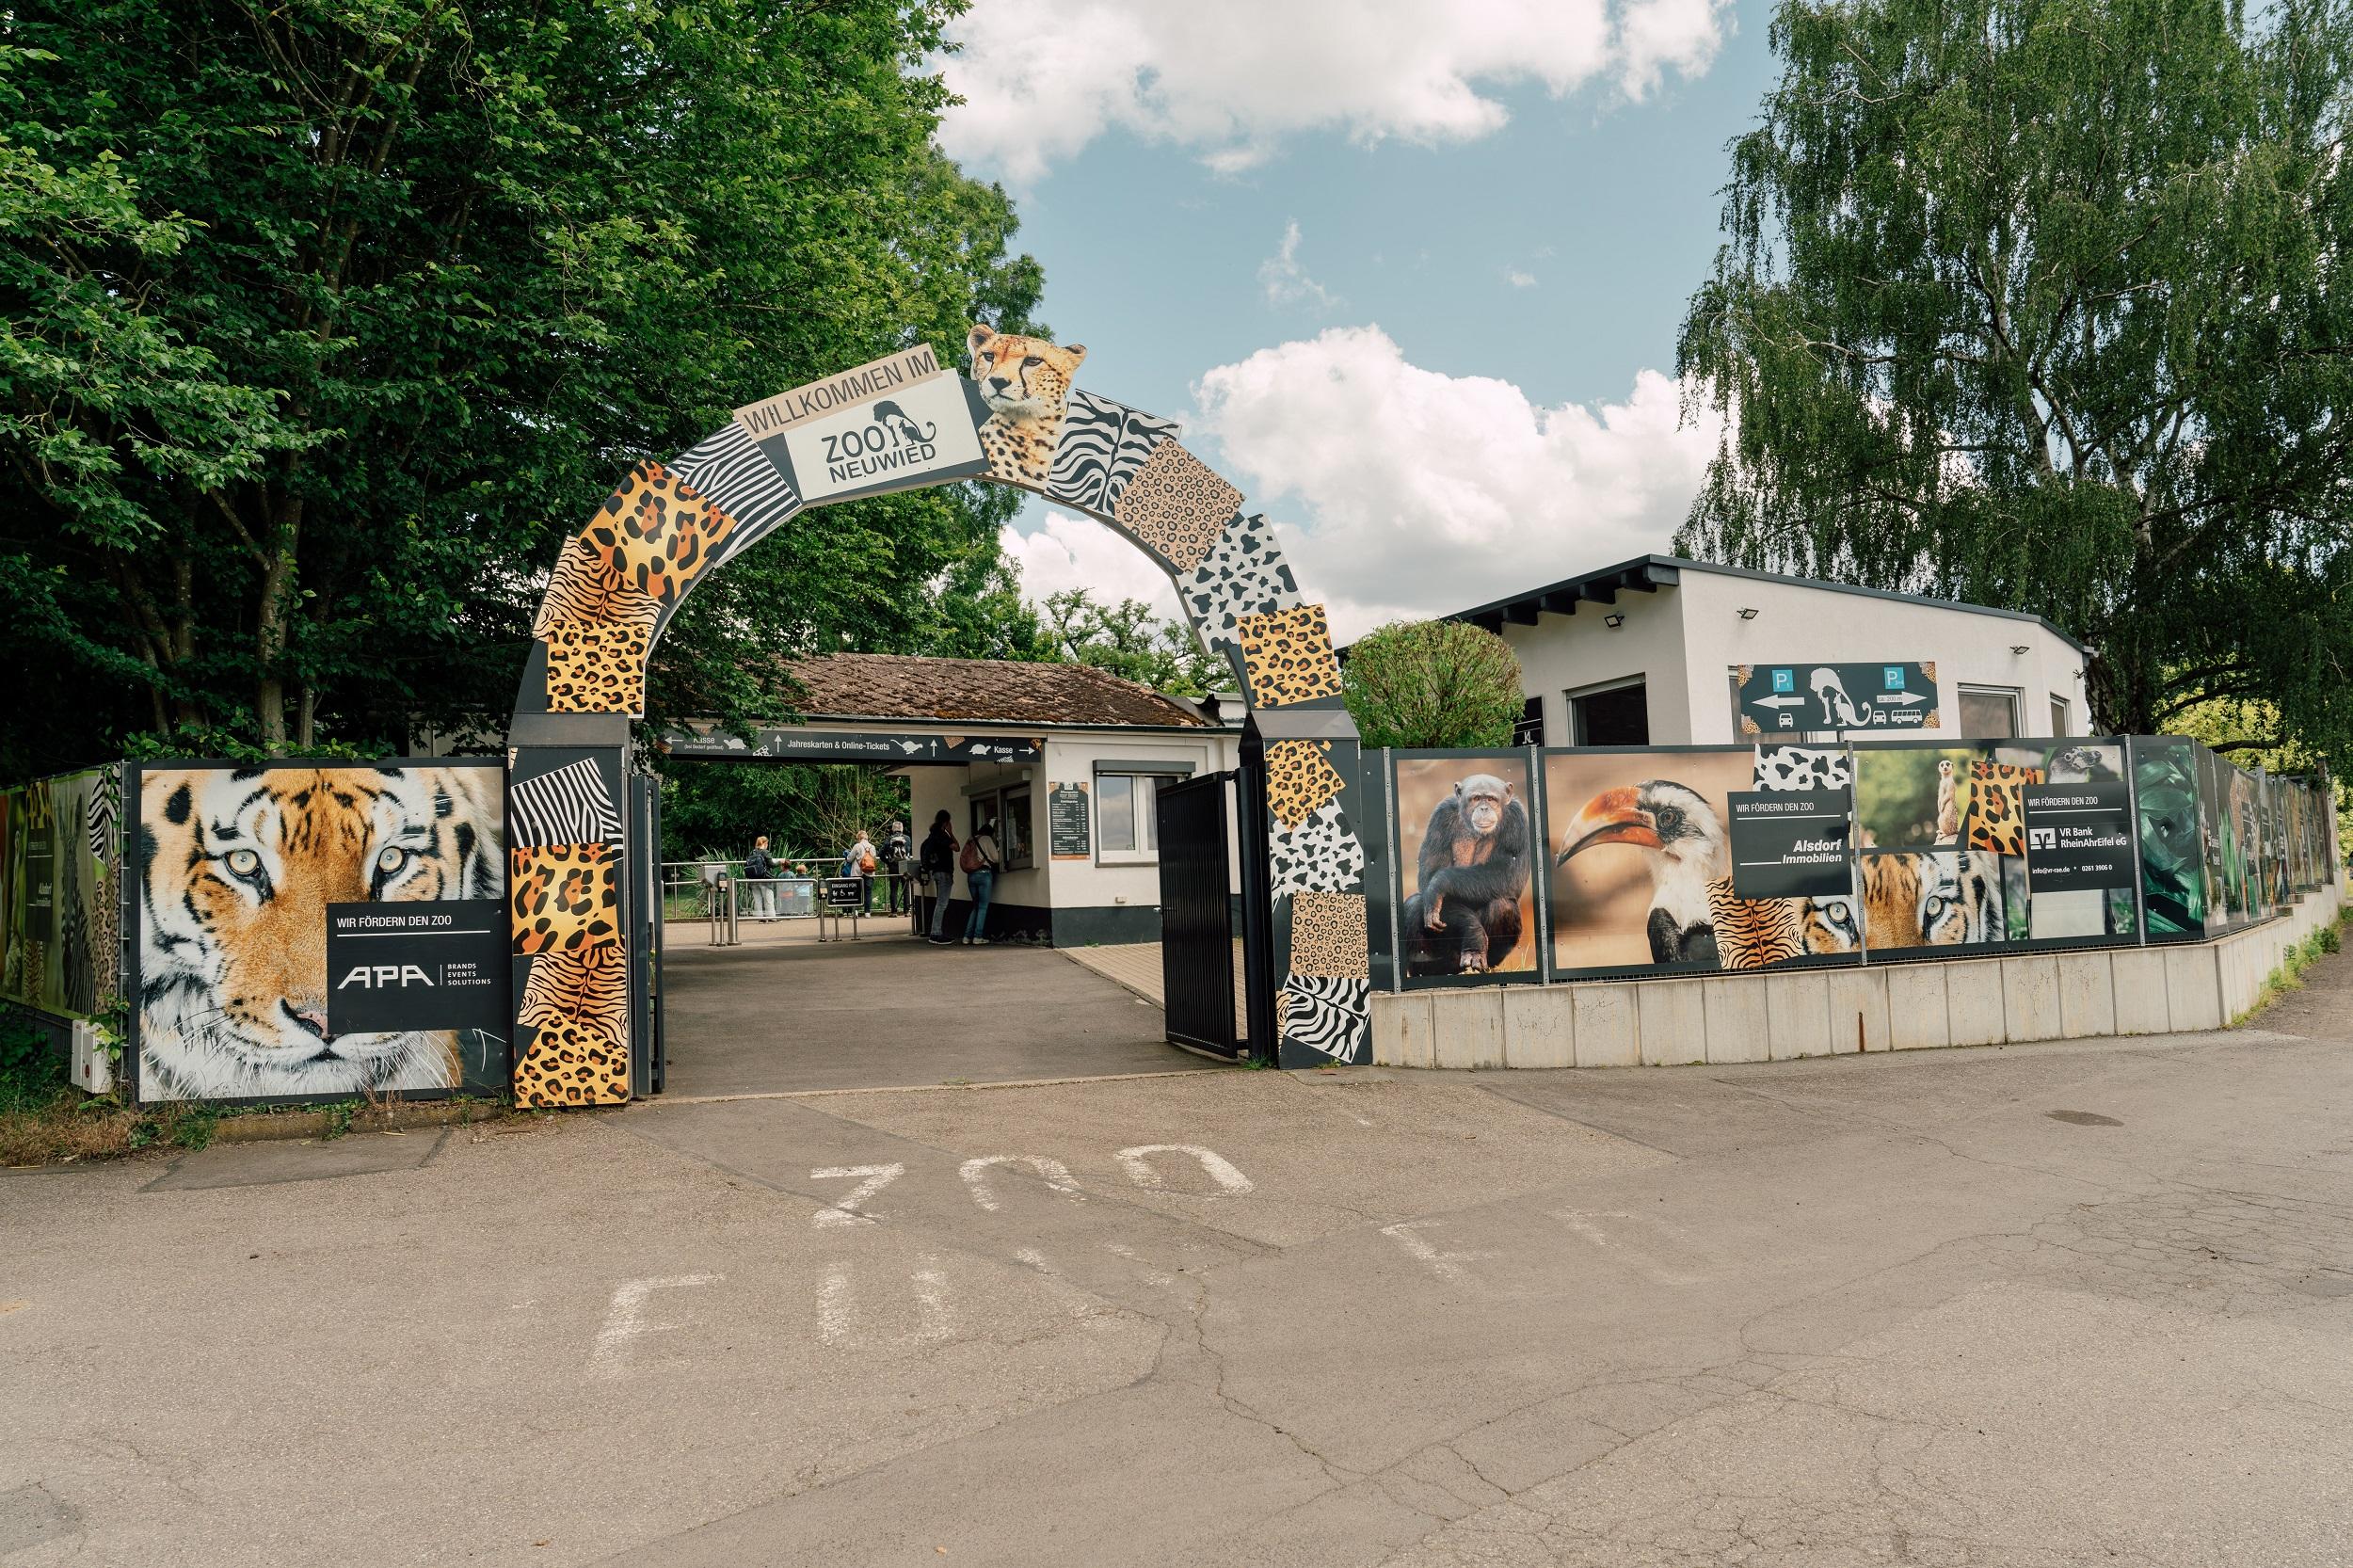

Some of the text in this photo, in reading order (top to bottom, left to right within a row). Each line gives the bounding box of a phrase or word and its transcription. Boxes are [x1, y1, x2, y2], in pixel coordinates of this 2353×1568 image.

[744, 351, 936, 433] WILLKOMMEN IM
[821, 424, 886, 464] ZOO
[828, 442, 936, 484] NEUWIED
[1776, 673, 1787, 688] P
[1886, 670, 1897, 686] P
[787, 739, 890, 751] Jahreskarten & Online-Tickets
[994, 745, 1013, 755] Kasse
[1736, 802, 1815, 812] WIR FÖRDERN DEN ZOO
[2027, 796, 2098, 807] WIR FÖRDERN DEN ZOO
[2059, 826, 2093, 837] VR Bank
[1793, 839, 1843, 853] Alsdorf
[2060, 837, 2127, 848] RheinAhrEifel eG
[1782, 854, 1843, 864] Immobilien
[2032, 866, 2071, 874] info@vr-rae.de
[336, 915, 452, 928] WIR FÖRDERN DEN ZOO
[337, 965, 435, 989] APA
[447, 978, 491, 986] SOLUTIONS
